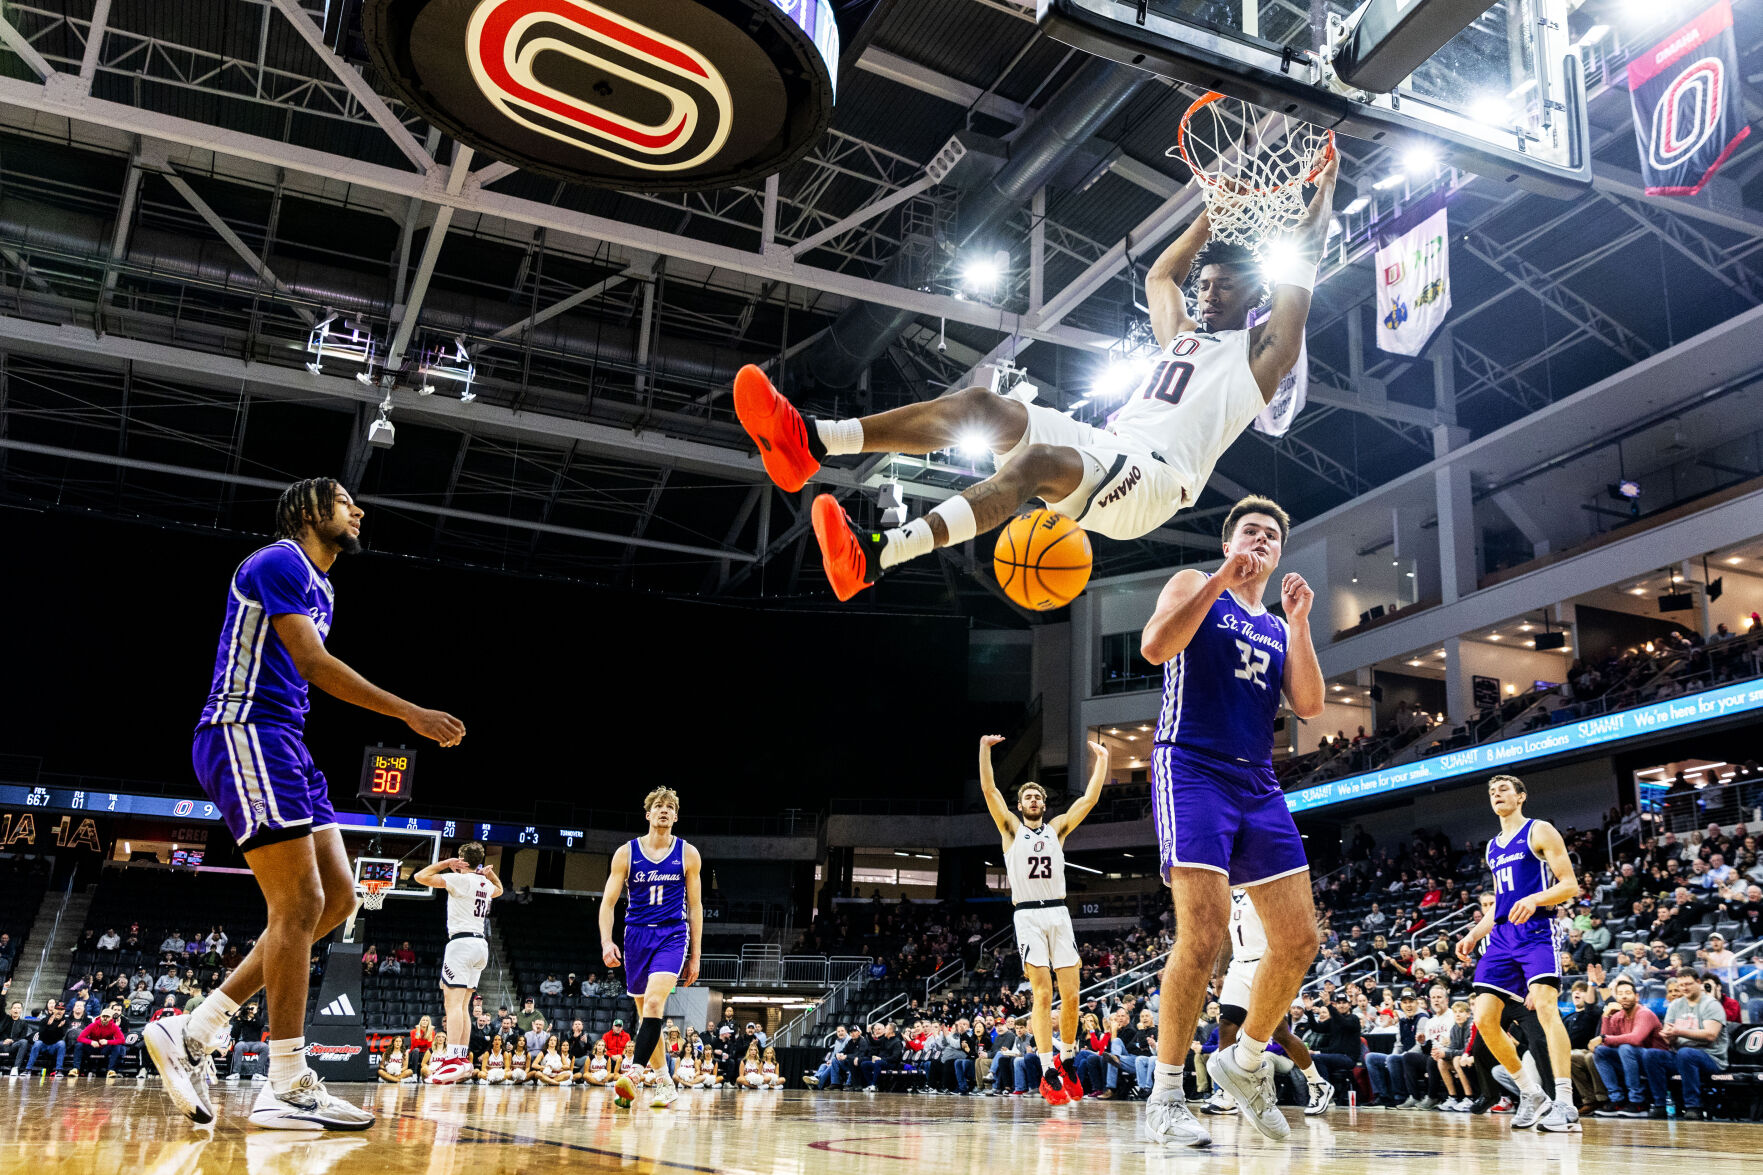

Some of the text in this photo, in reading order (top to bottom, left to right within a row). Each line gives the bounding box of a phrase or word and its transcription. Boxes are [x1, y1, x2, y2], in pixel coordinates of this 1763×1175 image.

[1655, 28, 1700, 64] OMAHA
[1143, 360, 1195, 405] 10
[1098, 465, 1141, 508] OMAHA
[1217, 613, 1284, 653] St. Thomas
[1234, 638, 1271, 691] 32
[1634, 709, 1668, 728] We're
[1670, 704, 1697, 720] here
[1697, 697, 1716, 714] for
[1717, 692, 1746, 714] your
[1578, 714, 1625, 739] SUMMIT
[1486, 749, 1495, 762] 8
[1495, 742, 1524, 761] Metro
[1525, 733, 1570, 753] Locations
[375, 755, 407, 771] 16:48
[1440, 749, 1478, 770] SUMMIT
[372, 769, 402, 794] 30
[1337, 780, 1360, 797] We're
[1360, 777, 1378, 792] here
[1378, 773, 1389, 788] for
[1390, 773, 1409, 789] your
[26, 793, 50, 807] 66.7
[72, 797, 85, 809] 01
[1302, 784, 1333, 804] SUMMIT
[107, 800, 116, 812] 4
[203, 804, 214, 817] 9
[443, 827, 455, 838] 20
[482, 830, 489, 841] 2
[519, 832, 526, 843] 0
[532, 833, 539, 844] 3
[560, 829, 584, 838] TURNOVERS
[566, 836, 573, 847] 0
[1028, 856, 1052, 880] 23
[1496, 851, 1526, 867] Thomas
[647, 869, 681, 882] Thomas
[1495, 866, 1515, 895] 14
[648, 885, 664, 906] 11
[1083, 904, 1099, 914] 102
